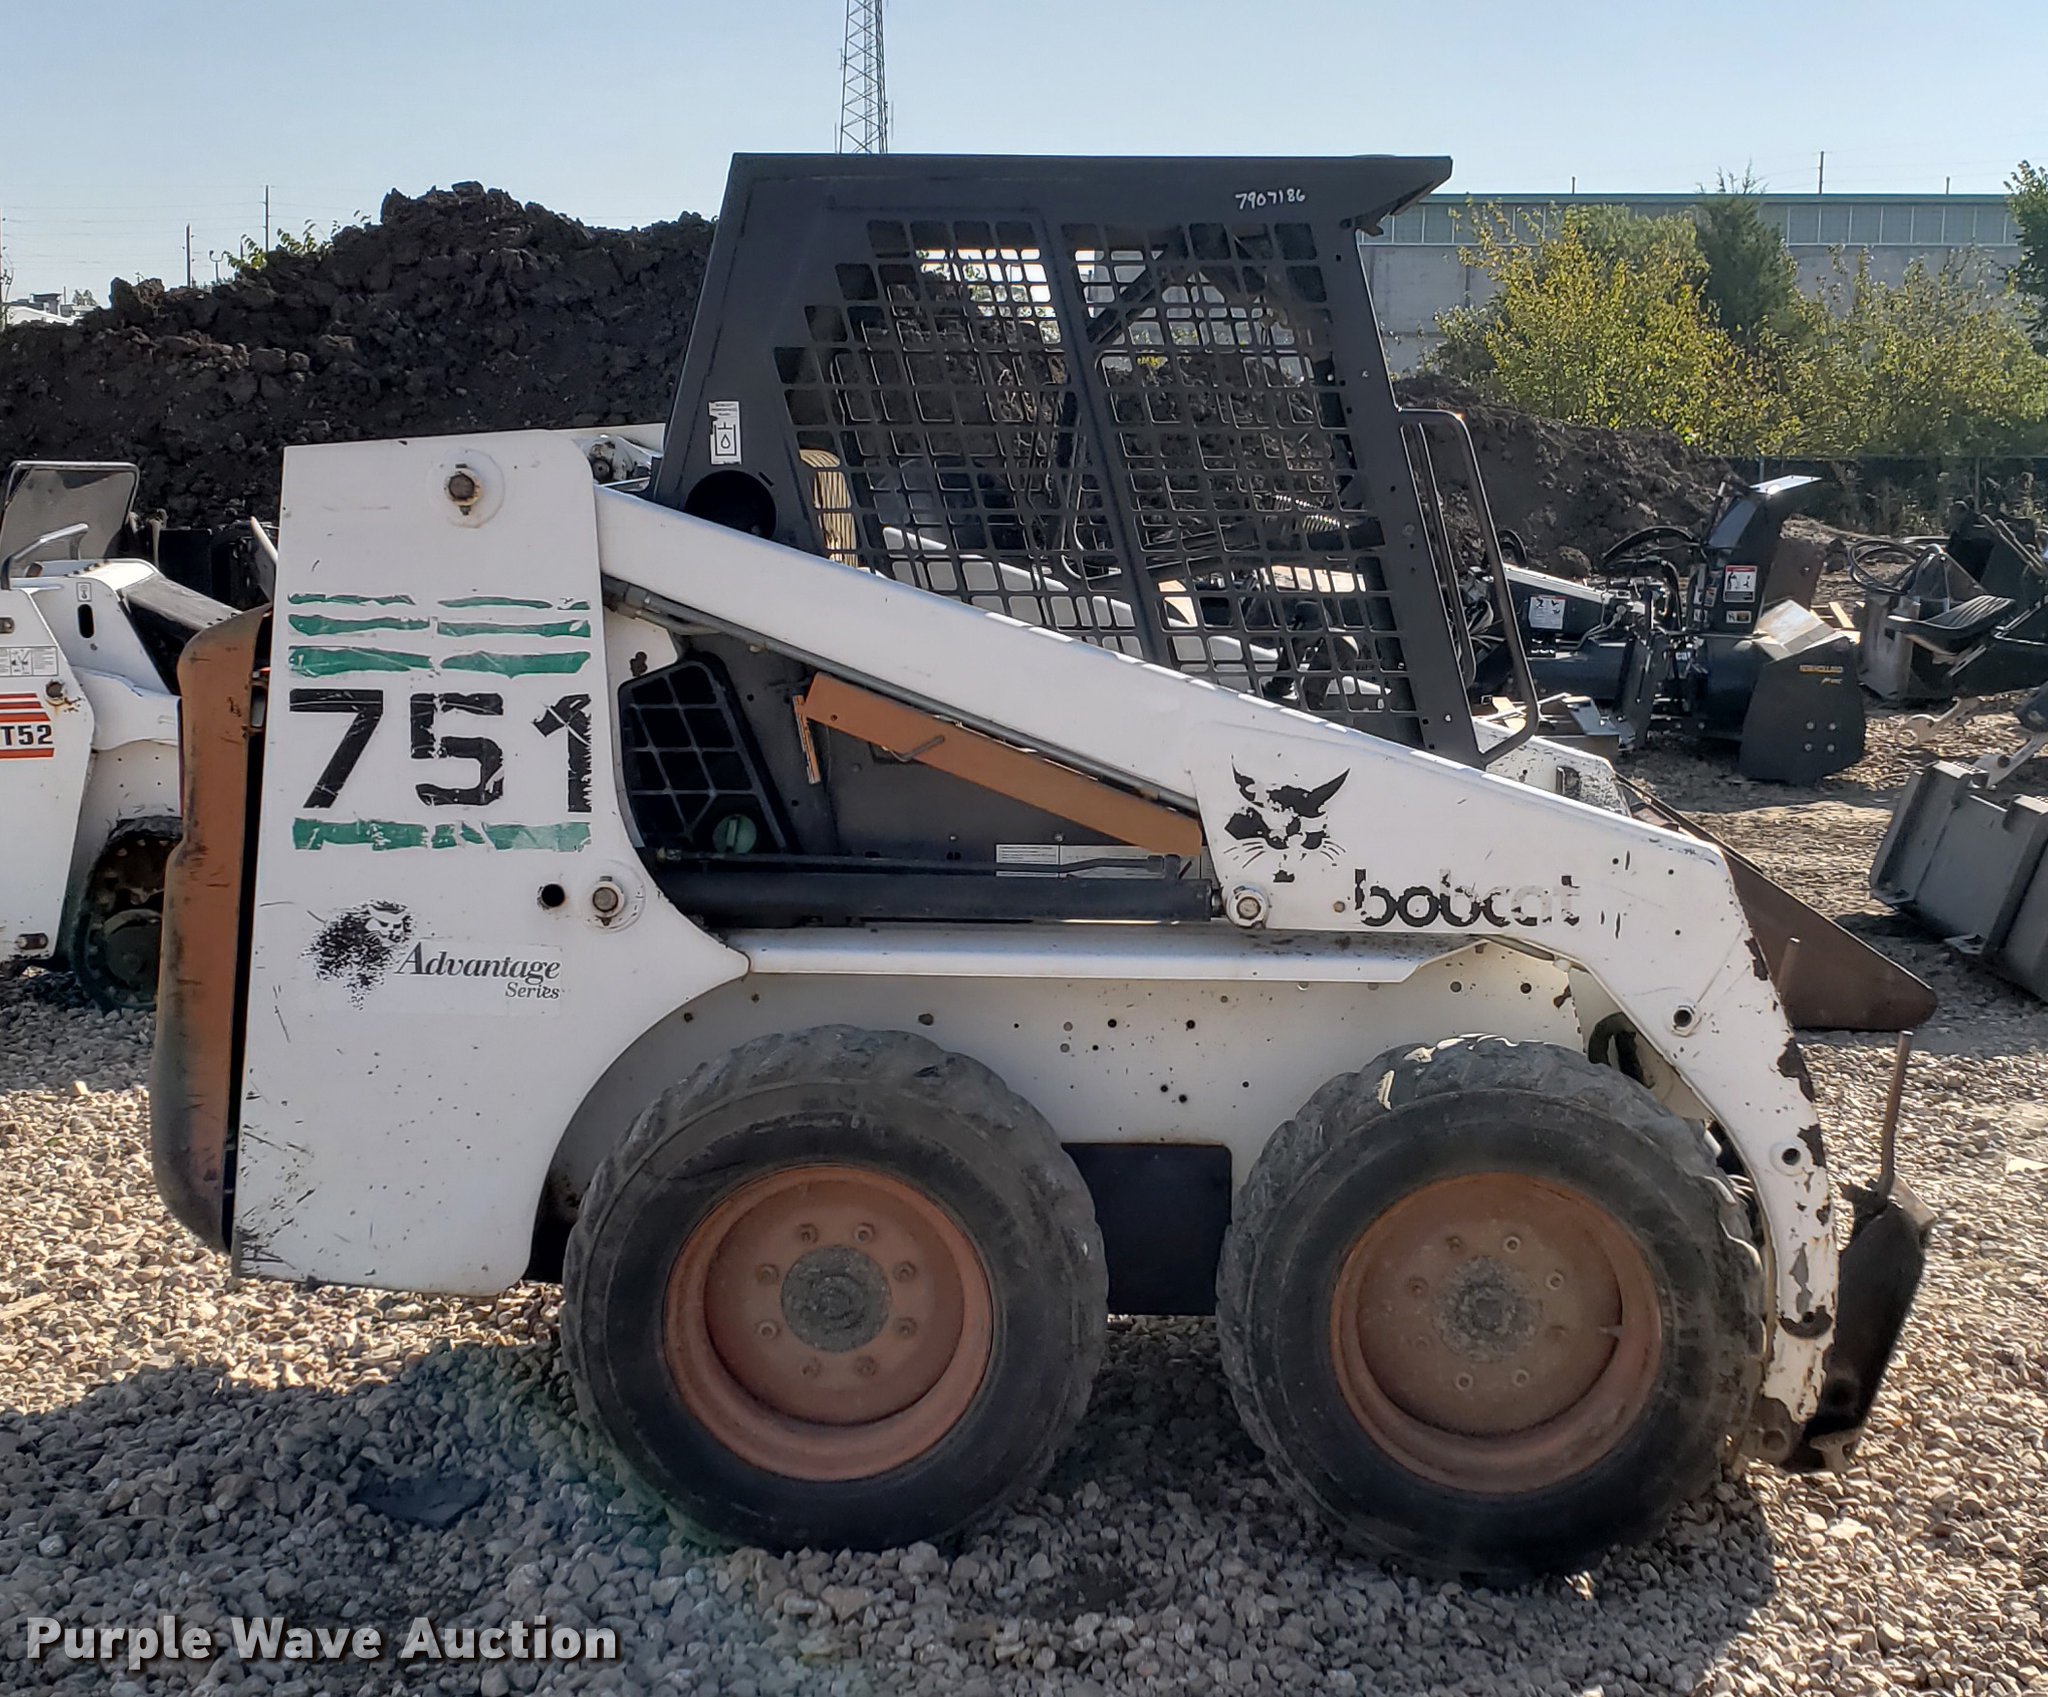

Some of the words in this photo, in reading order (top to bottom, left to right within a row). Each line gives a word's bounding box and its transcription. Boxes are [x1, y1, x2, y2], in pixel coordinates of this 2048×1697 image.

[1235, 188, 1306, 210] 7907186
[0, 724, 53, 746] T52
[289, 688, 592, 813] 751
[394, 941, 561, 986] Advantage
[505, 980, 561, 999] Series
